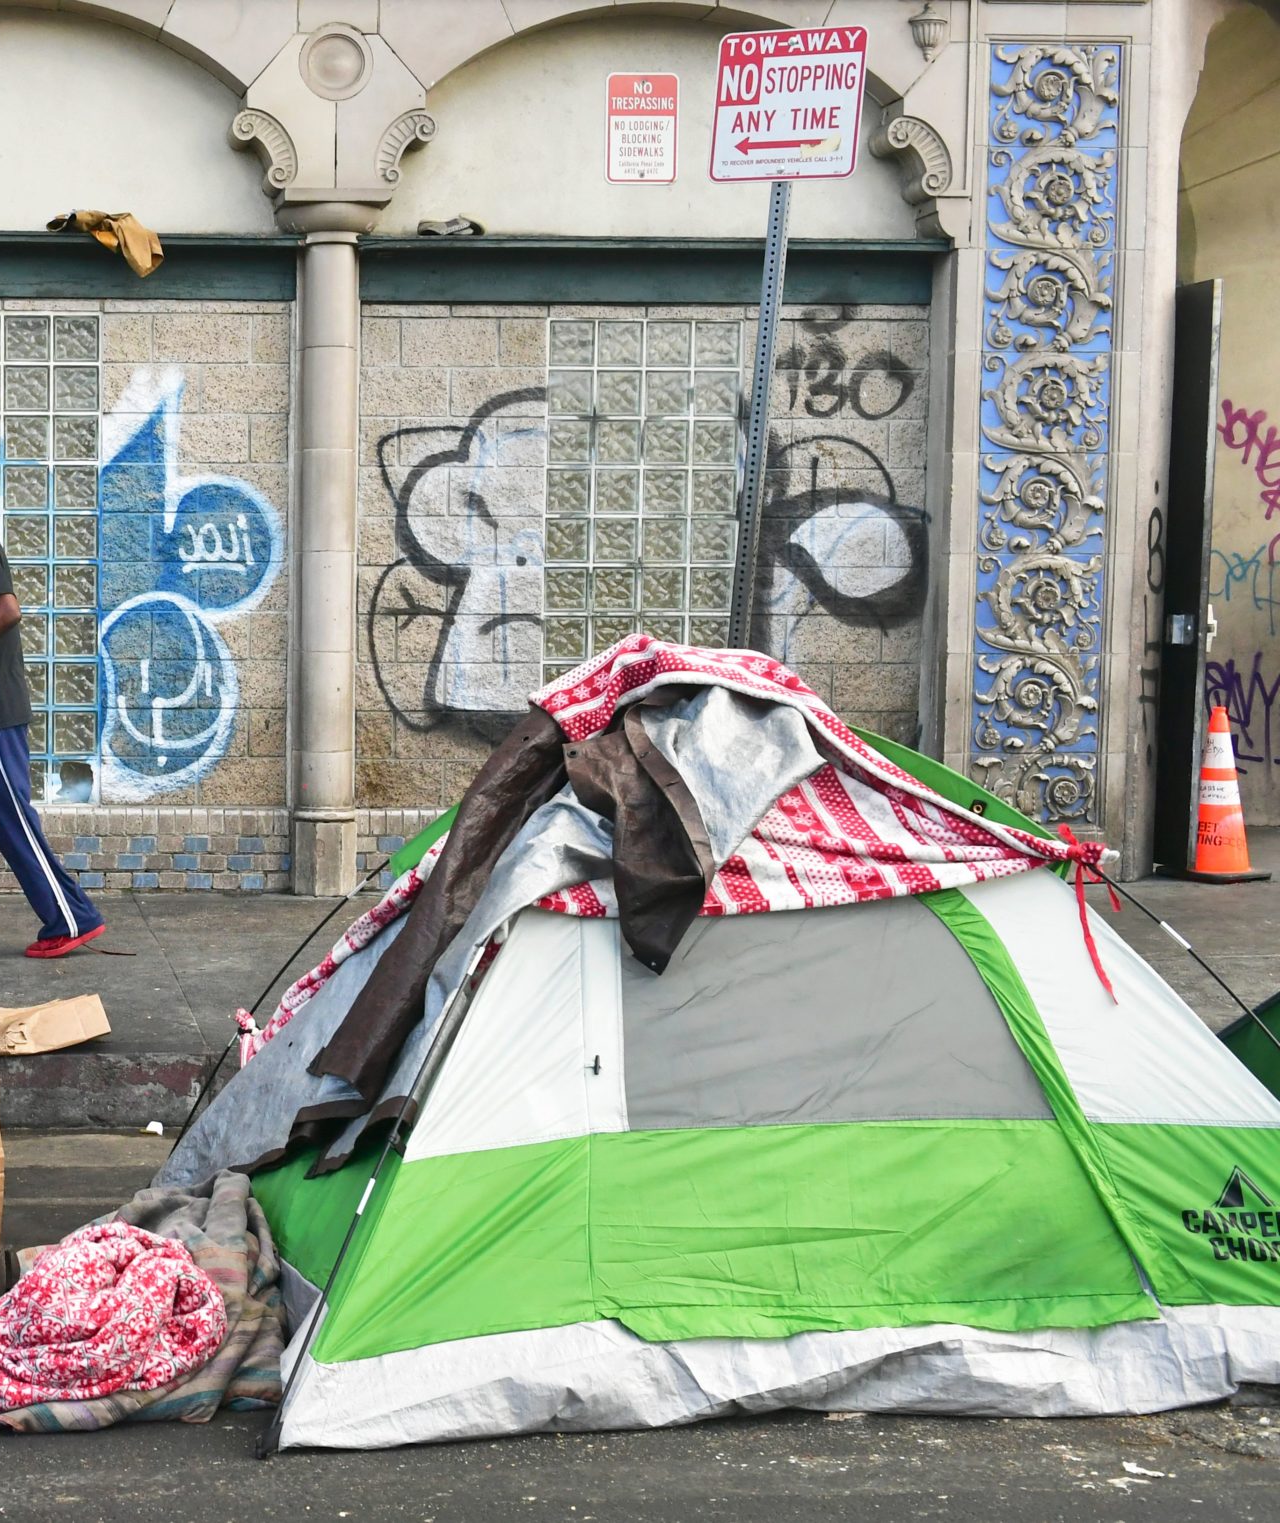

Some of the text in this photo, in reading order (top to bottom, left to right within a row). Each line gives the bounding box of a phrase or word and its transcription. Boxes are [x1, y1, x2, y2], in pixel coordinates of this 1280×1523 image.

[727, 29, 862, 57] TOW-AWAY
[633, 81, 653, 95] NO
[720, 62, 857, 102] NO STOPPING
[611, 96, 674, 111] TRESPASSING
[614, 120, 626, 131] NO
[731, 106, 841, 134] ANY TIME
[621, 133, 662, 144] BLOCKING
[619, 146, 664, 157] SIDEWALKS
[755, 157, 785, 165] IMPOUNDED
[1197, 821, 1218, 833] EET
[1196, 833, 1223, 847] TING
[1181, 1210, 1280, 1237] CAMPE
